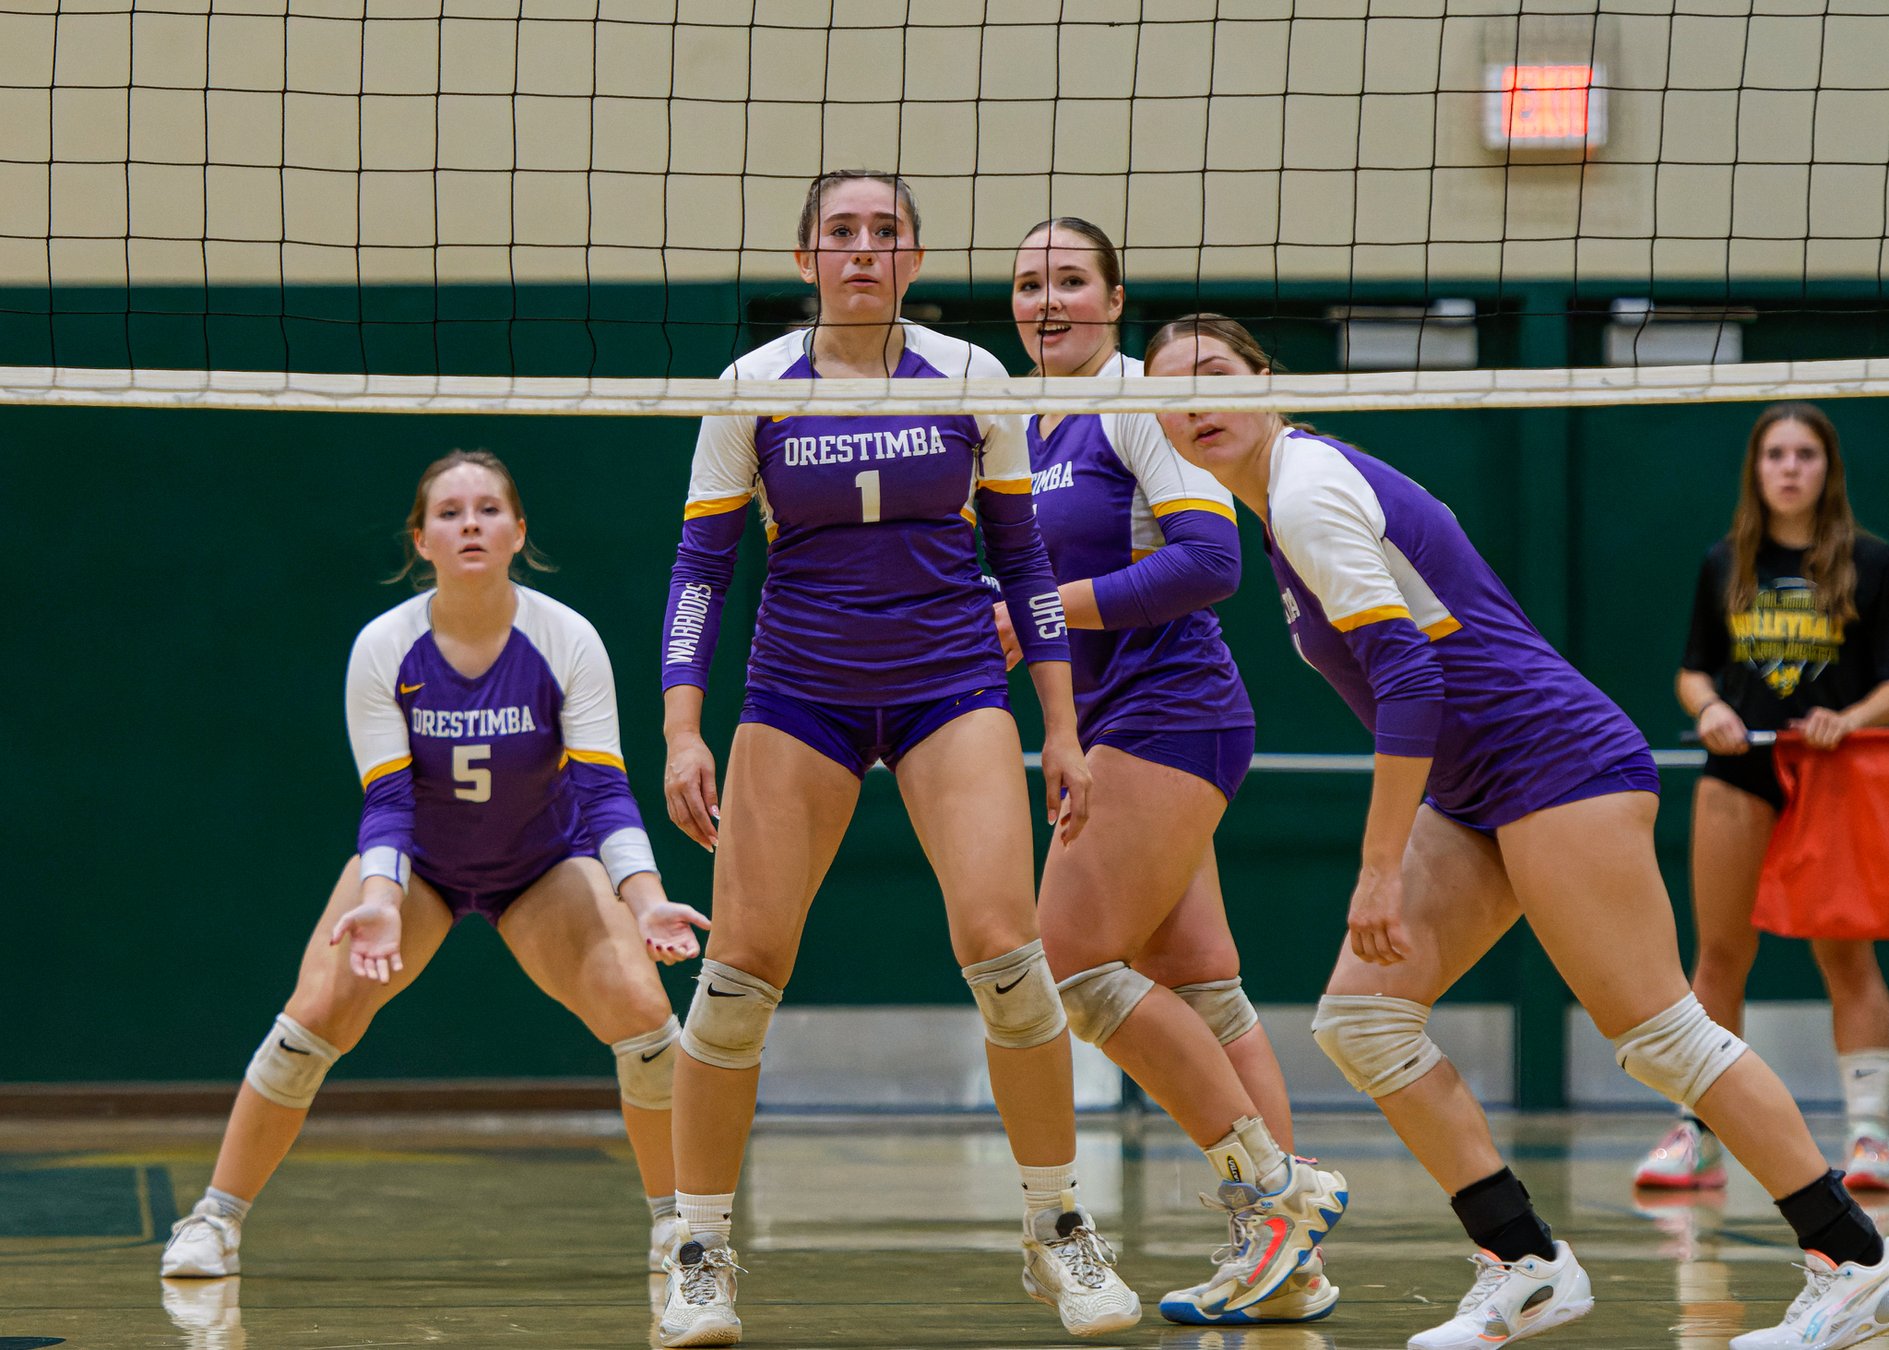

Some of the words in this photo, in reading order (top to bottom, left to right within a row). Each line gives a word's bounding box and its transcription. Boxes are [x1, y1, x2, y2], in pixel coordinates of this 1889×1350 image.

[785, 425, 947, 467] ORESTIMBA
[855, 469, 881, 524] 1
[665, 582, 712, 665] WARRIORS
[1028, 591, 1068, 640] OHS
[412, 705, 536, 738] ORESTIMBA
[453, 744, 491, 803] 5
